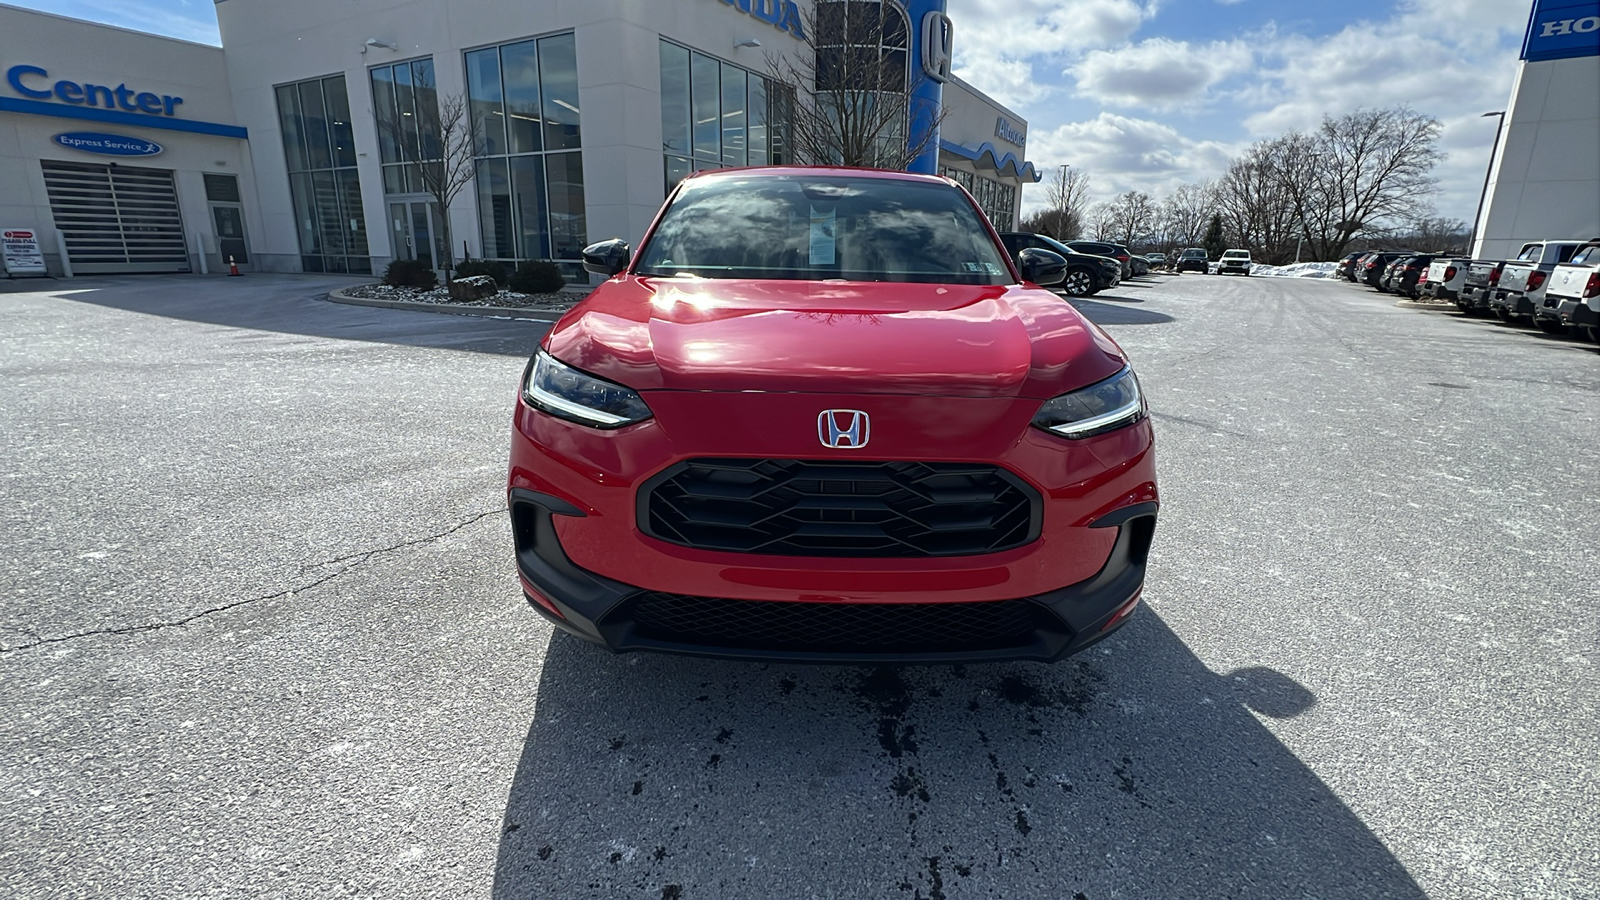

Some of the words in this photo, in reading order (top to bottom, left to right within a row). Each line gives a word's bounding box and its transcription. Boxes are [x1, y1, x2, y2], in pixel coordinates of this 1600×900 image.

[1539, 16, 1600, 37] HO
[7, 64, 183, 116] Center
[60, 136, 102, 146] Express
[104, 140, 142, 151] Service
